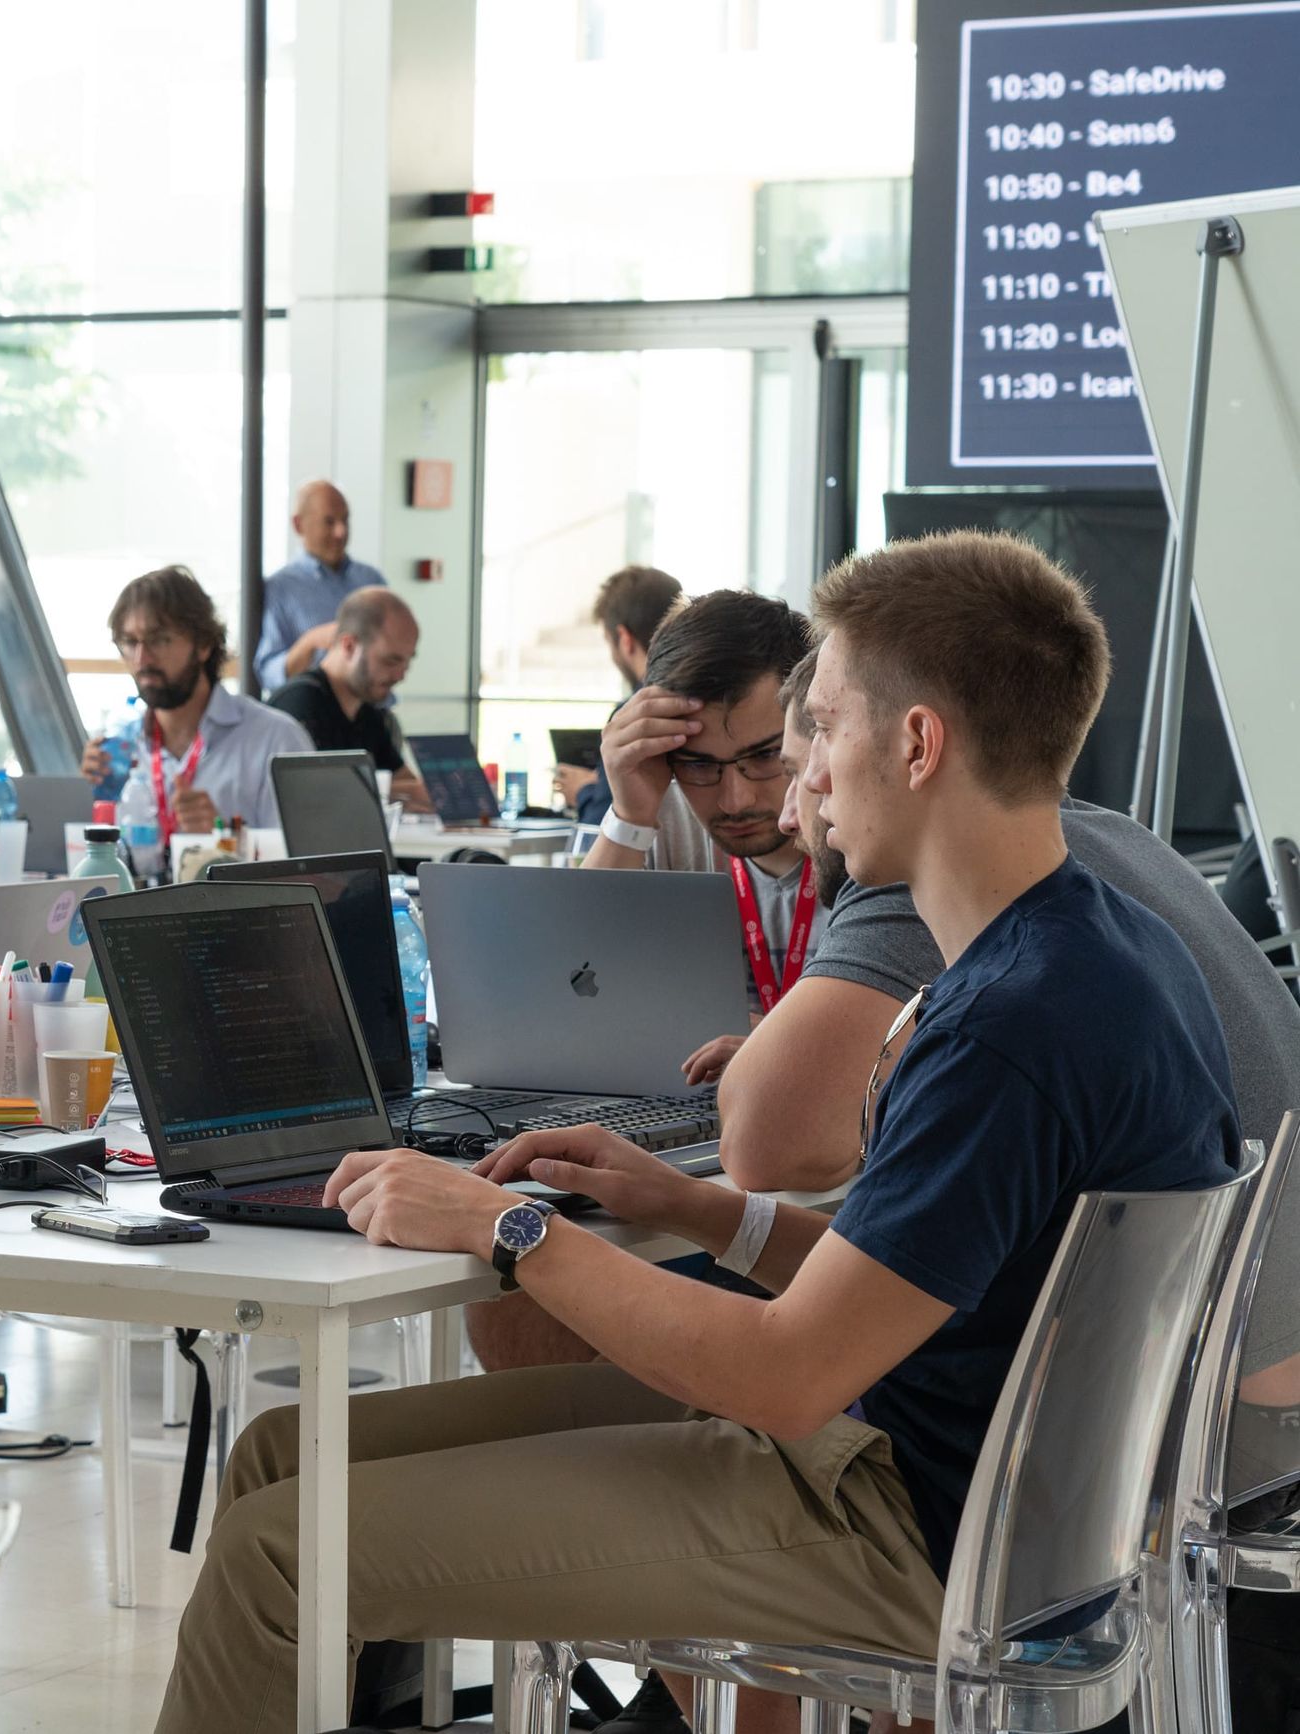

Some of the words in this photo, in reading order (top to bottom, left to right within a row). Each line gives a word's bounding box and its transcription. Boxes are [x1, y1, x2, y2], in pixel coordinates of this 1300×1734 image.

[987, 71, 1066, 101] 10:30
[1089, 64, 1226, 97] SafeDrive
[986, 121, 1064, 150] 10:40
[1088, 116, 1176, 147] Sens6
[984, 172, 1063, 200] 10:50
[1086, 169, 1142, 196] Be4
[983, 222, 1061, 249] 11:00
[982, 273, 1060, 300] 11:10
[980, 323, 1059, 350] 11:20
[979, 373, 1057, 400] 11:30
[1081, 372, 1139, 398] Icar
